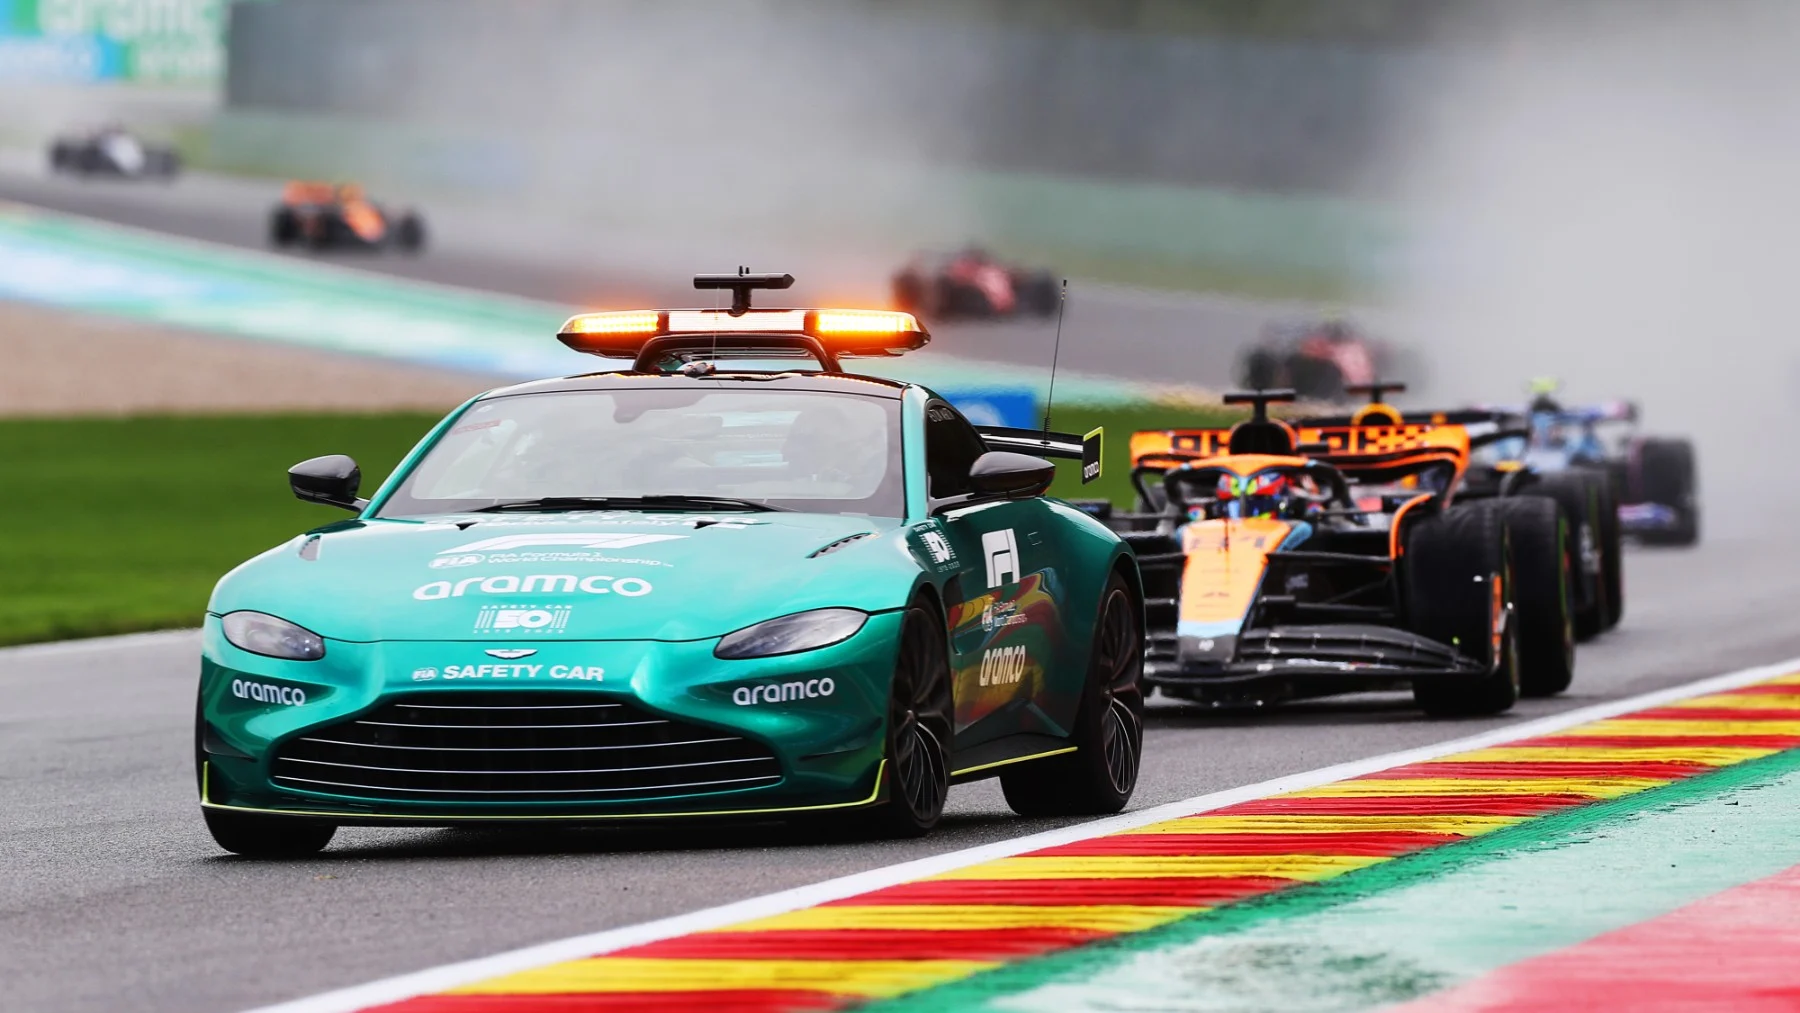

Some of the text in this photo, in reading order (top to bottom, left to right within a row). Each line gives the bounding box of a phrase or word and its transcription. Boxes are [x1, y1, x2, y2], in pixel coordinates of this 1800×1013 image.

[430, 555, 480, 568] FIA
[539, 555, 662, 566] Championship
[412, 574, 653, 600] aramco
[492, 609, 553, 629] 50
[442, 664, 544, 680] SAFETY
[549, 665, 605, 682] CAR
[979, 645, 1026, 687] aramco
[232, 679, 306, 707] aramco
[732, 677, 836, 706] aramco
